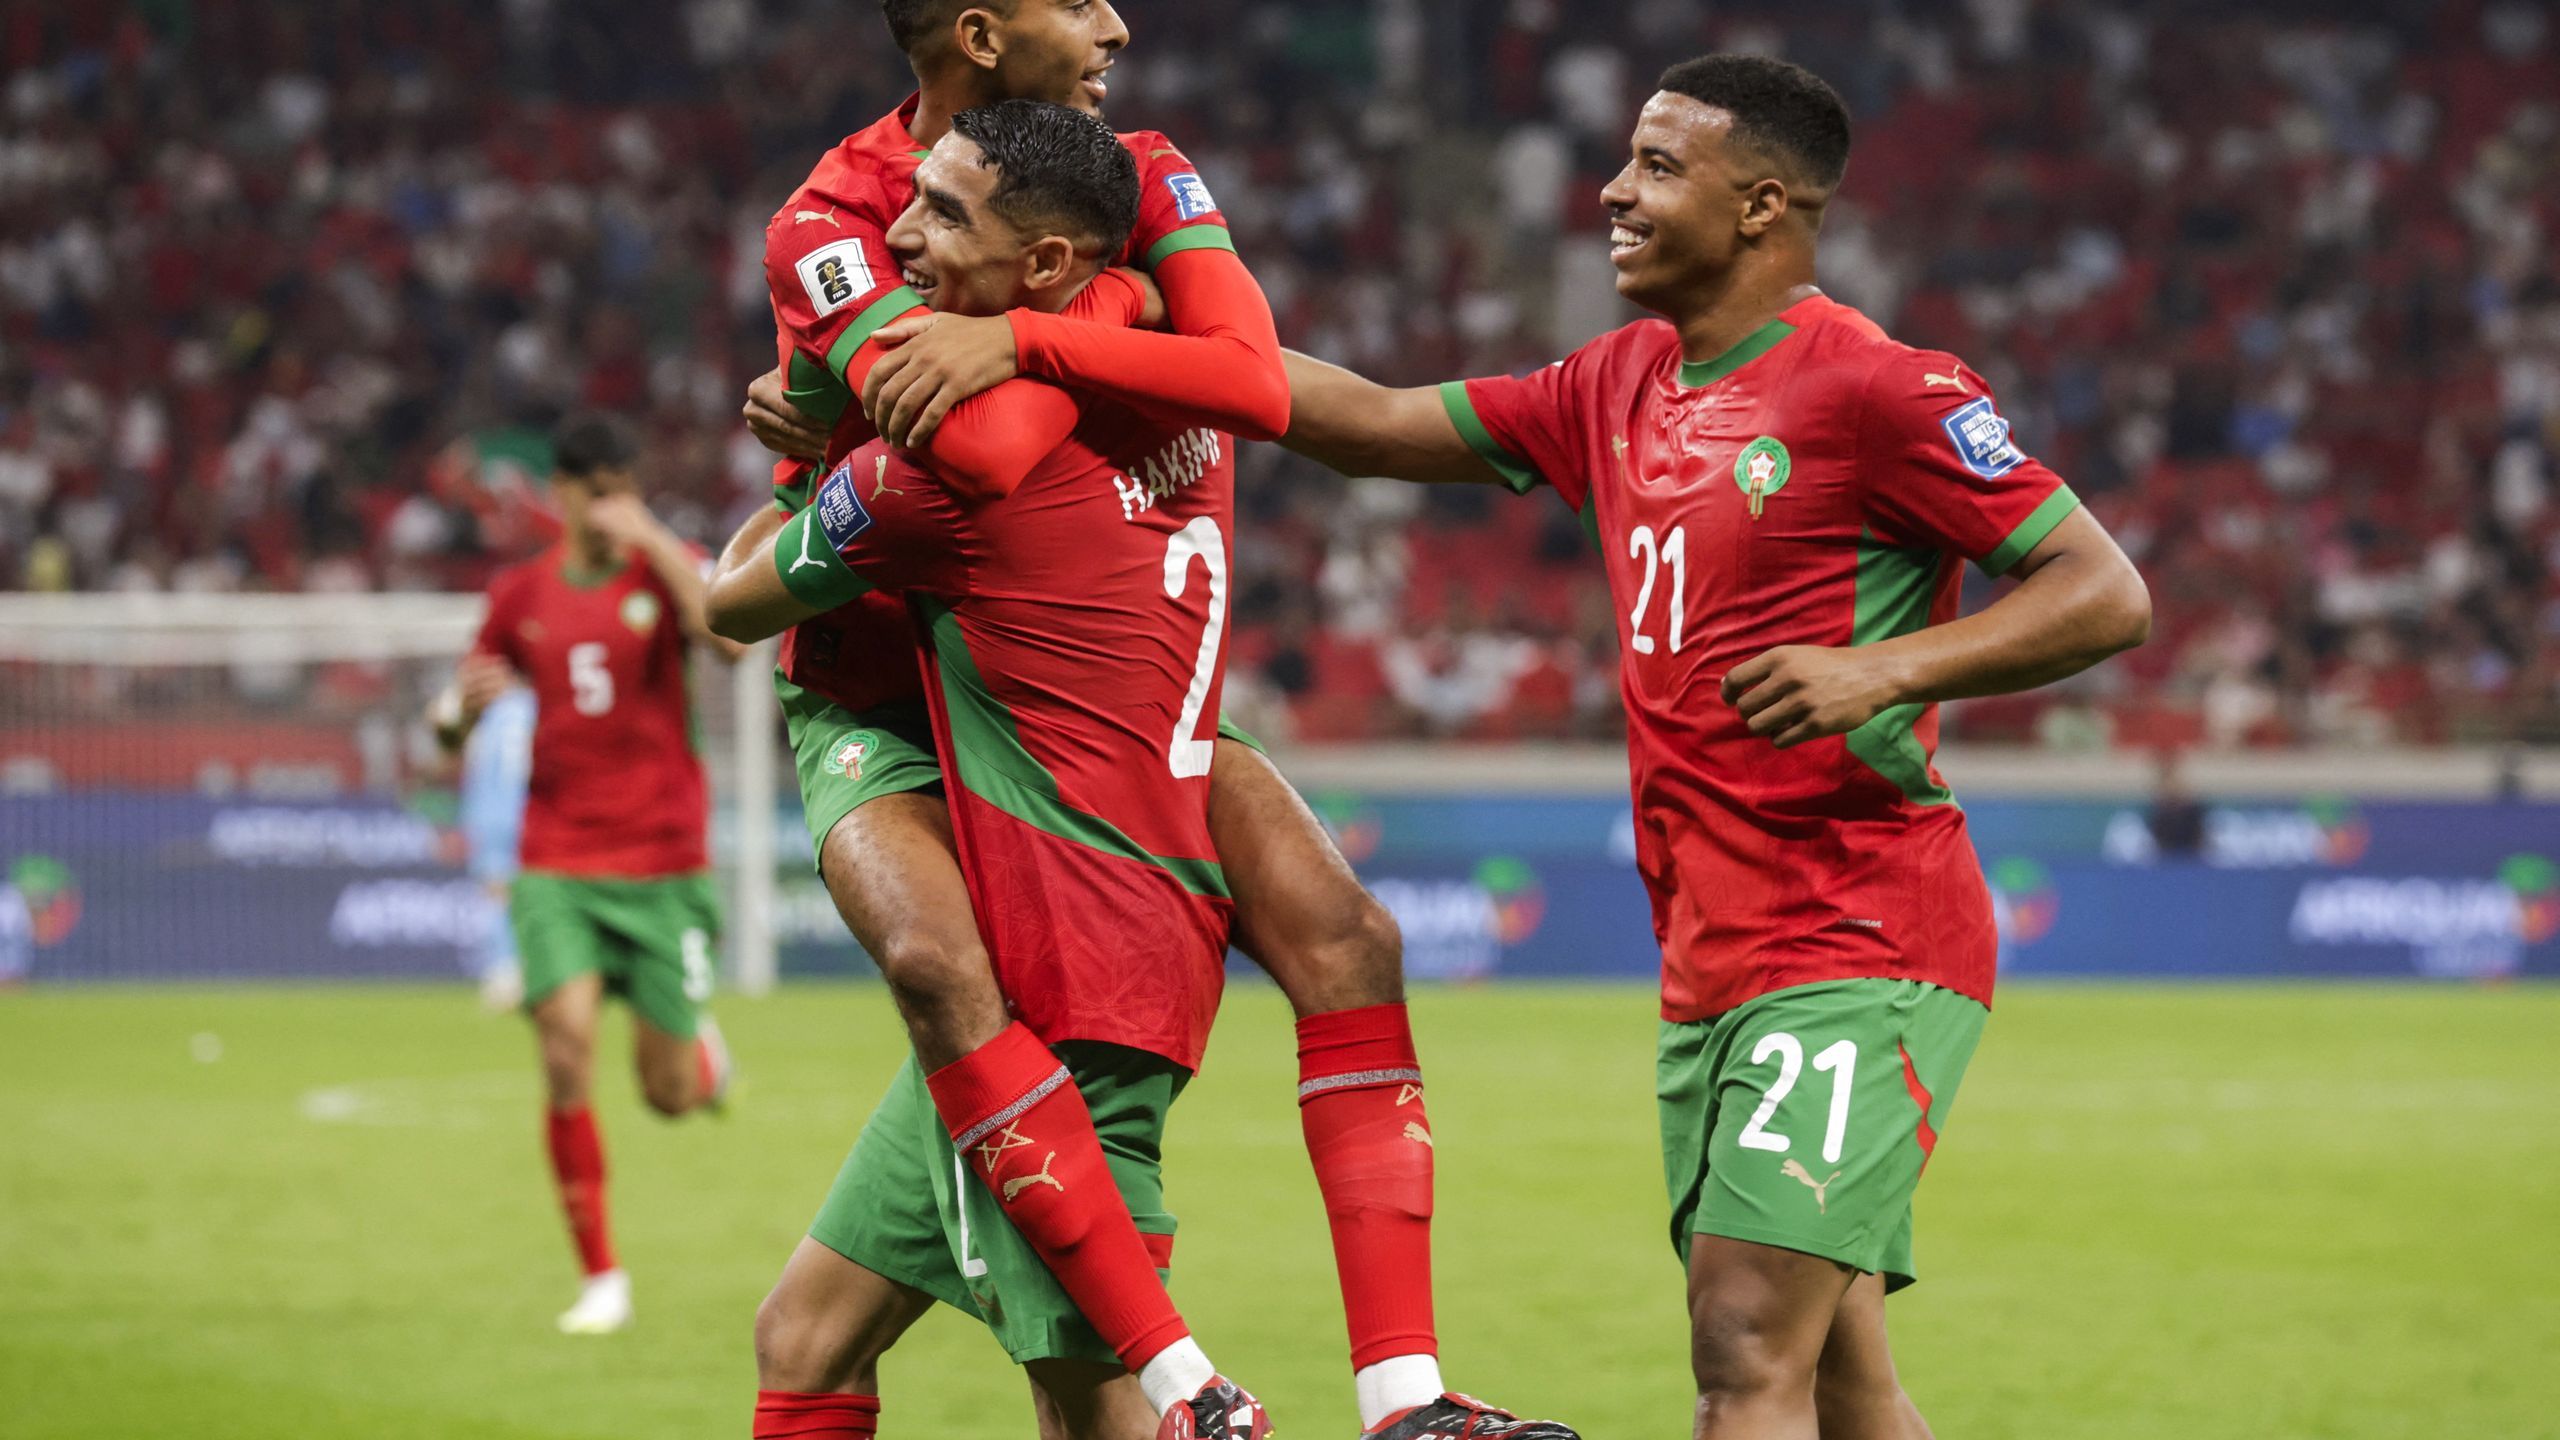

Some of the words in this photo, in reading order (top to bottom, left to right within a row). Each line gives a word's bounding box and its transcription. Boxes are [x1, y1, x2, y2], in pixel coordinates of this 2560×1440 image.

[832, 289, 847, 300] FIFA
[1966, 420, 2001, 447] UNITES
[838, 479, 857, 520] FOOTBALL
[1113, 428, 1220, 520] HAKIMI
[827, 505, 846, 533] World
[830, 485, 852, 526] UNITES
[1630, 525, 1685, 655] 21
[1164, 516, 1226, 778] 2
[568, 640, 615, 718] 5
[1738, 1032, 1858, 1163] 21
